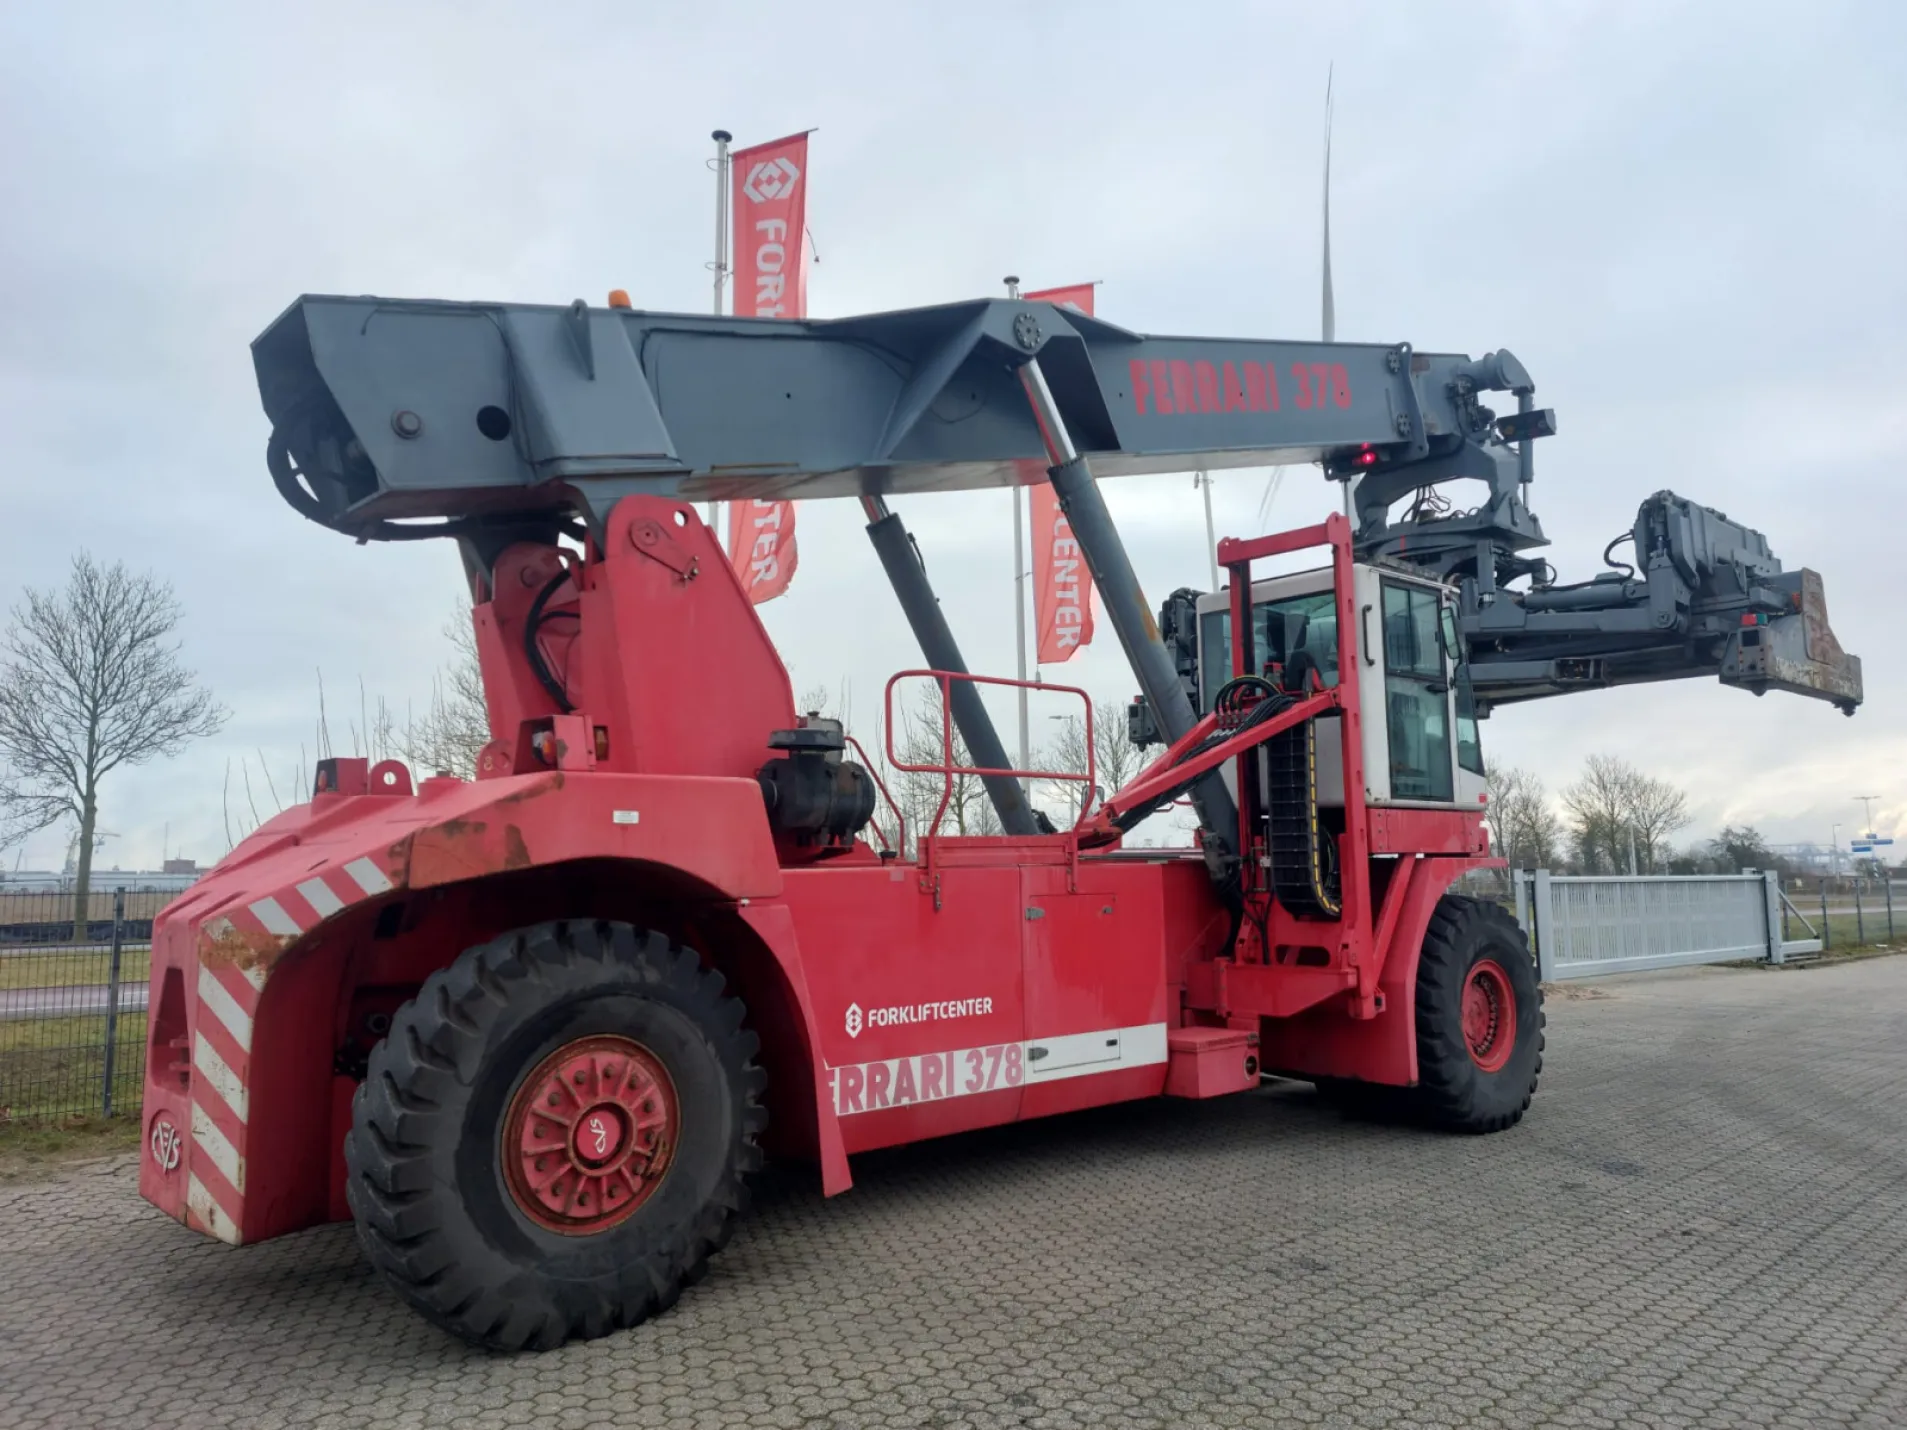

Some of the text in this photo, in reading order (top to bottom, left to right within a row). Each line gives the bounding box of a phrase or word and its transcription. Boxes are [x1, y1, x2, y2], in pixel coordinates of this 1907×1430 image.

[1129, 359, 1352, 415] FERRARI 378
[1053, 501, 1082, 649] CENTER
[868, 997, 992, 1028] FORKLIFTCENTER
[964, 1043, 1023, 1093] 378
